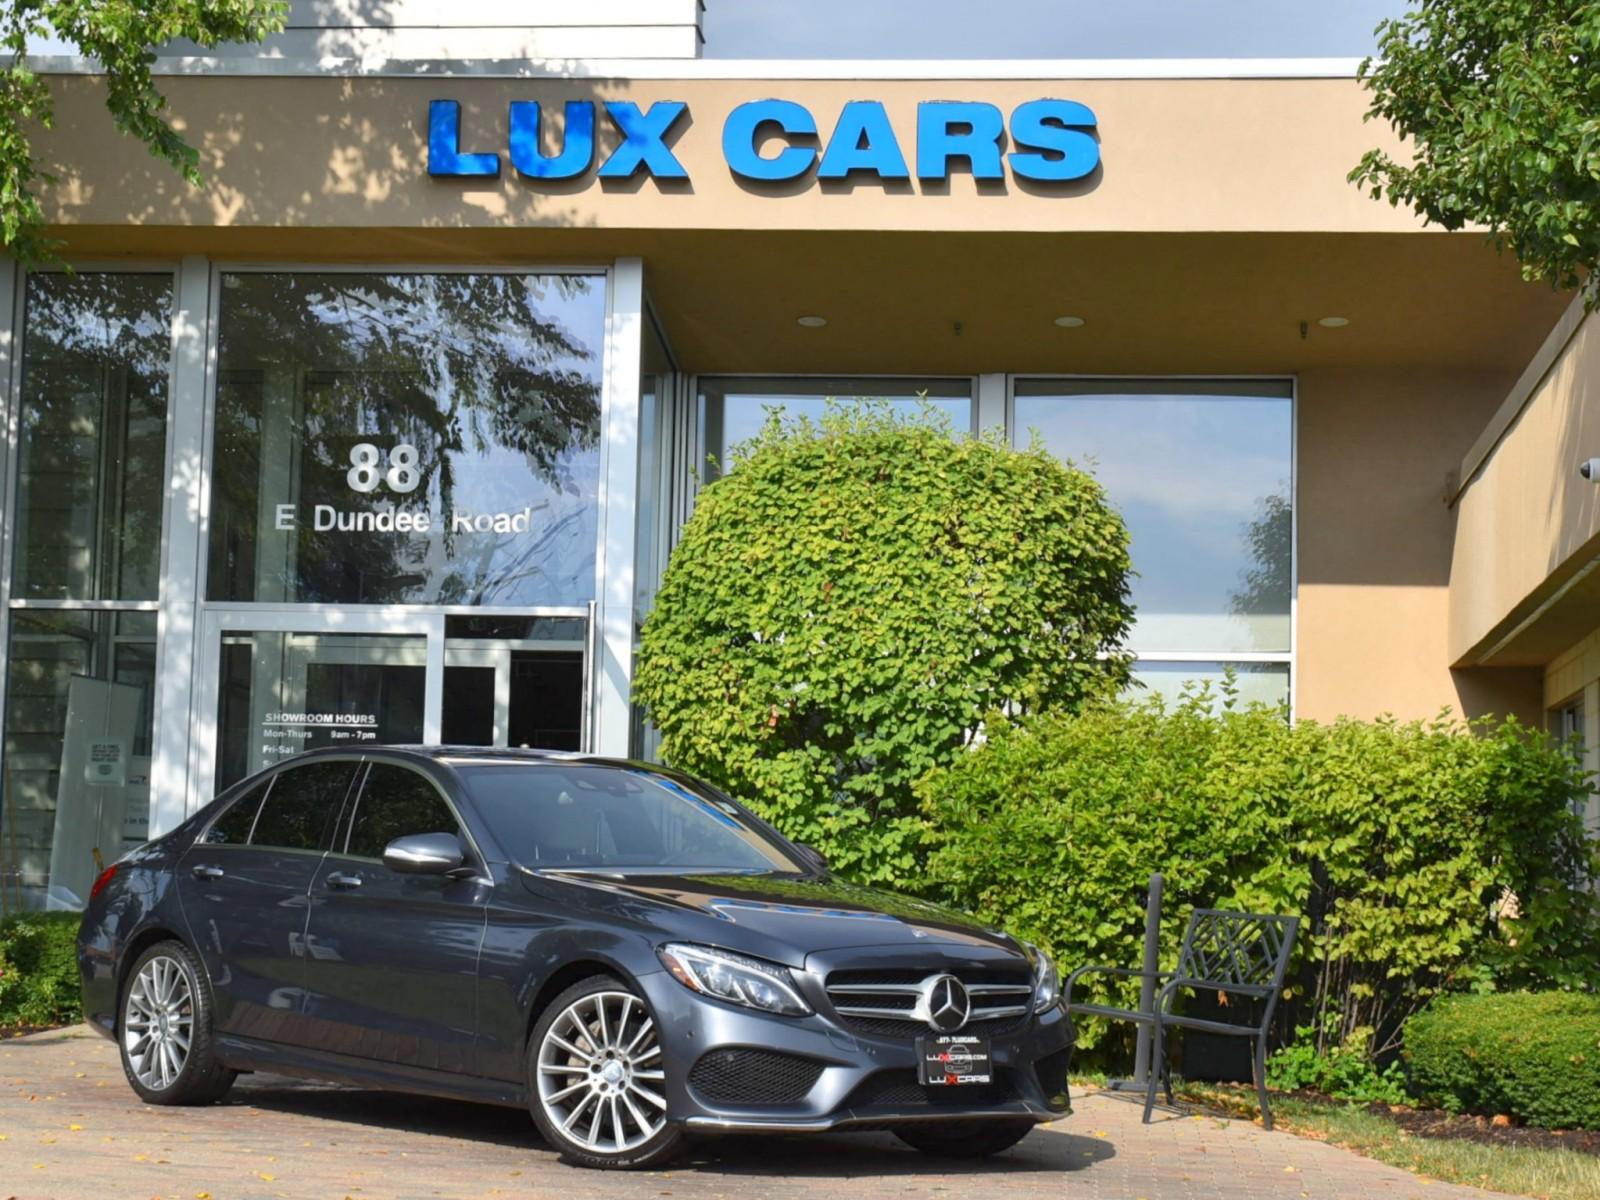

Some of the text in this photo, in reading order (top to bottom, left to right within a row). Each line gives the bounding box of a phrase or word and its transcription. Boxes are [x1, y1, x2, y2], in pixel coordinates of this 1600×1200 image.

[428, 98, 1102, 183] LUX CARS
[346, 443, 420, 493] 88
[275, 504, 532, 533] E Dundee Road
[265, 712, 376, 724] SHOWROOM HOURS
[263, 729, 313, 739] Mon-Thurs
[330, 730, 350, 739] 9am
[262, 744, 295, 754] Fri-Sat
